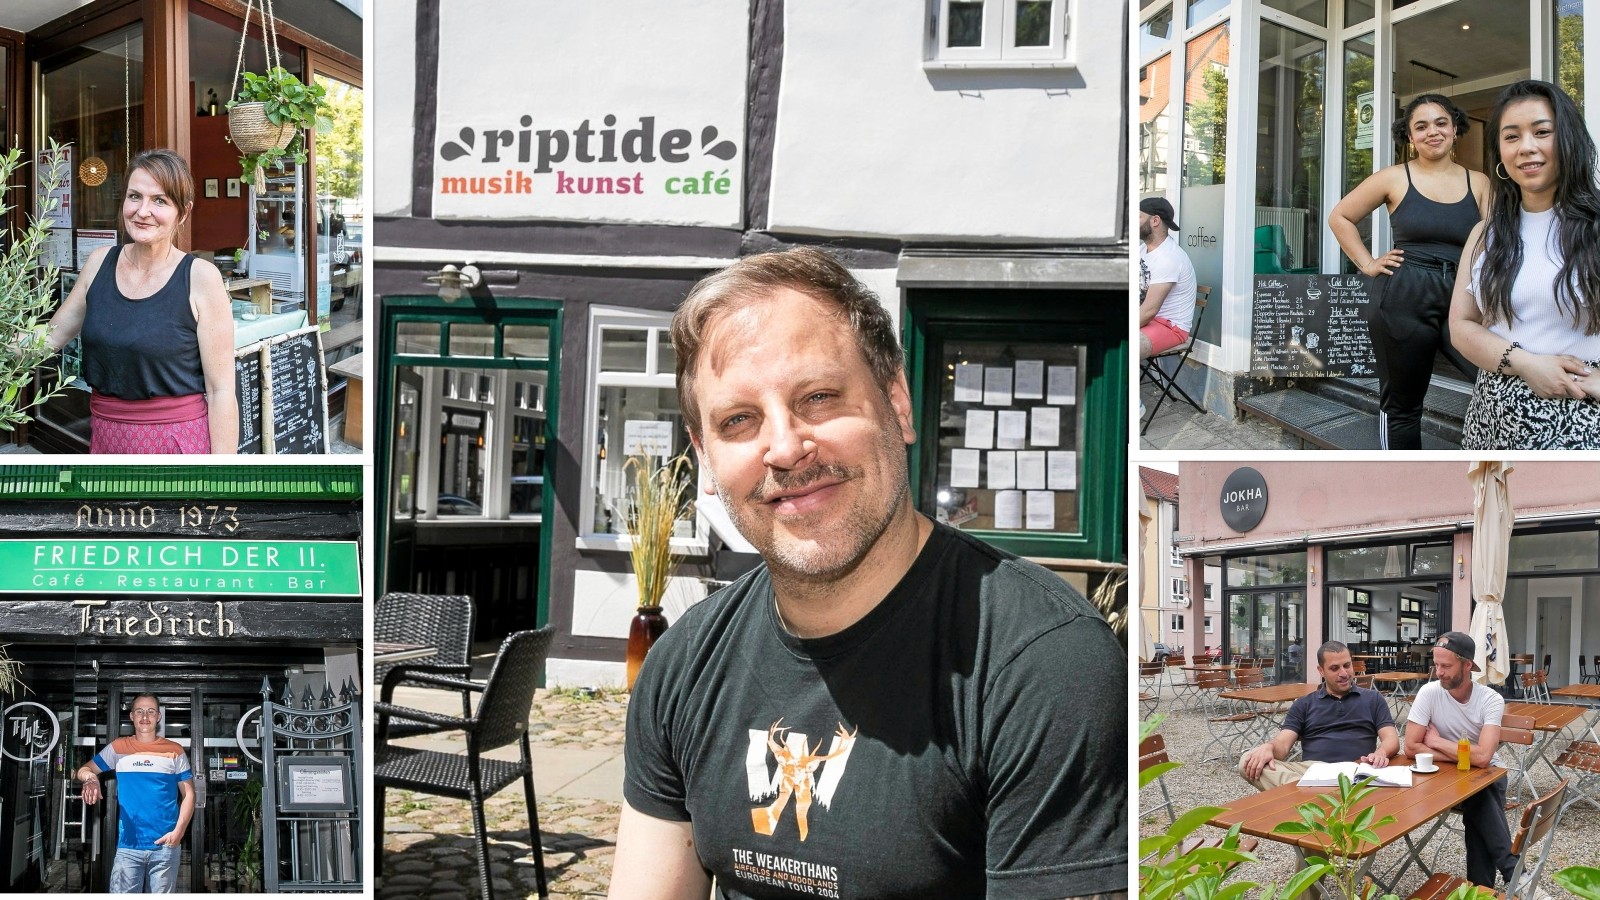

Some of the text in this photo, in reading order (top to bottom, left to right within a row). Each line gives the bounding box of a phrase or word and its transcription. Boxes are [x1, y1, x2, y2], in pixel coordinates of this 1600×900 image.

[481, 114, 692, 174] riptide
[441, 168, 731, 195] musik kunst café
[1188, 226, 1217, 248] coffee
[1330, 307, 1359, 316] Hot Stuff
[1223, 488, 1263, 504] JOKHA
[1236, 504, 1250, 512] BAR
[75, 505, 240, 532] Anno 1973
[34, 545, 325, 567] FRIEDRICH DER II.
[32, 573, 327, 590] Café Restaurant Bar
[74, 600, 235, 637] Friedrich
[732, 848, 838, 881] THE WEAKERTHANS
[734, 863, 839, 890] AIRFIELDS AND WOODLANDS
[735, 870, 840, 899] EUROPEAN TOUR 2004
